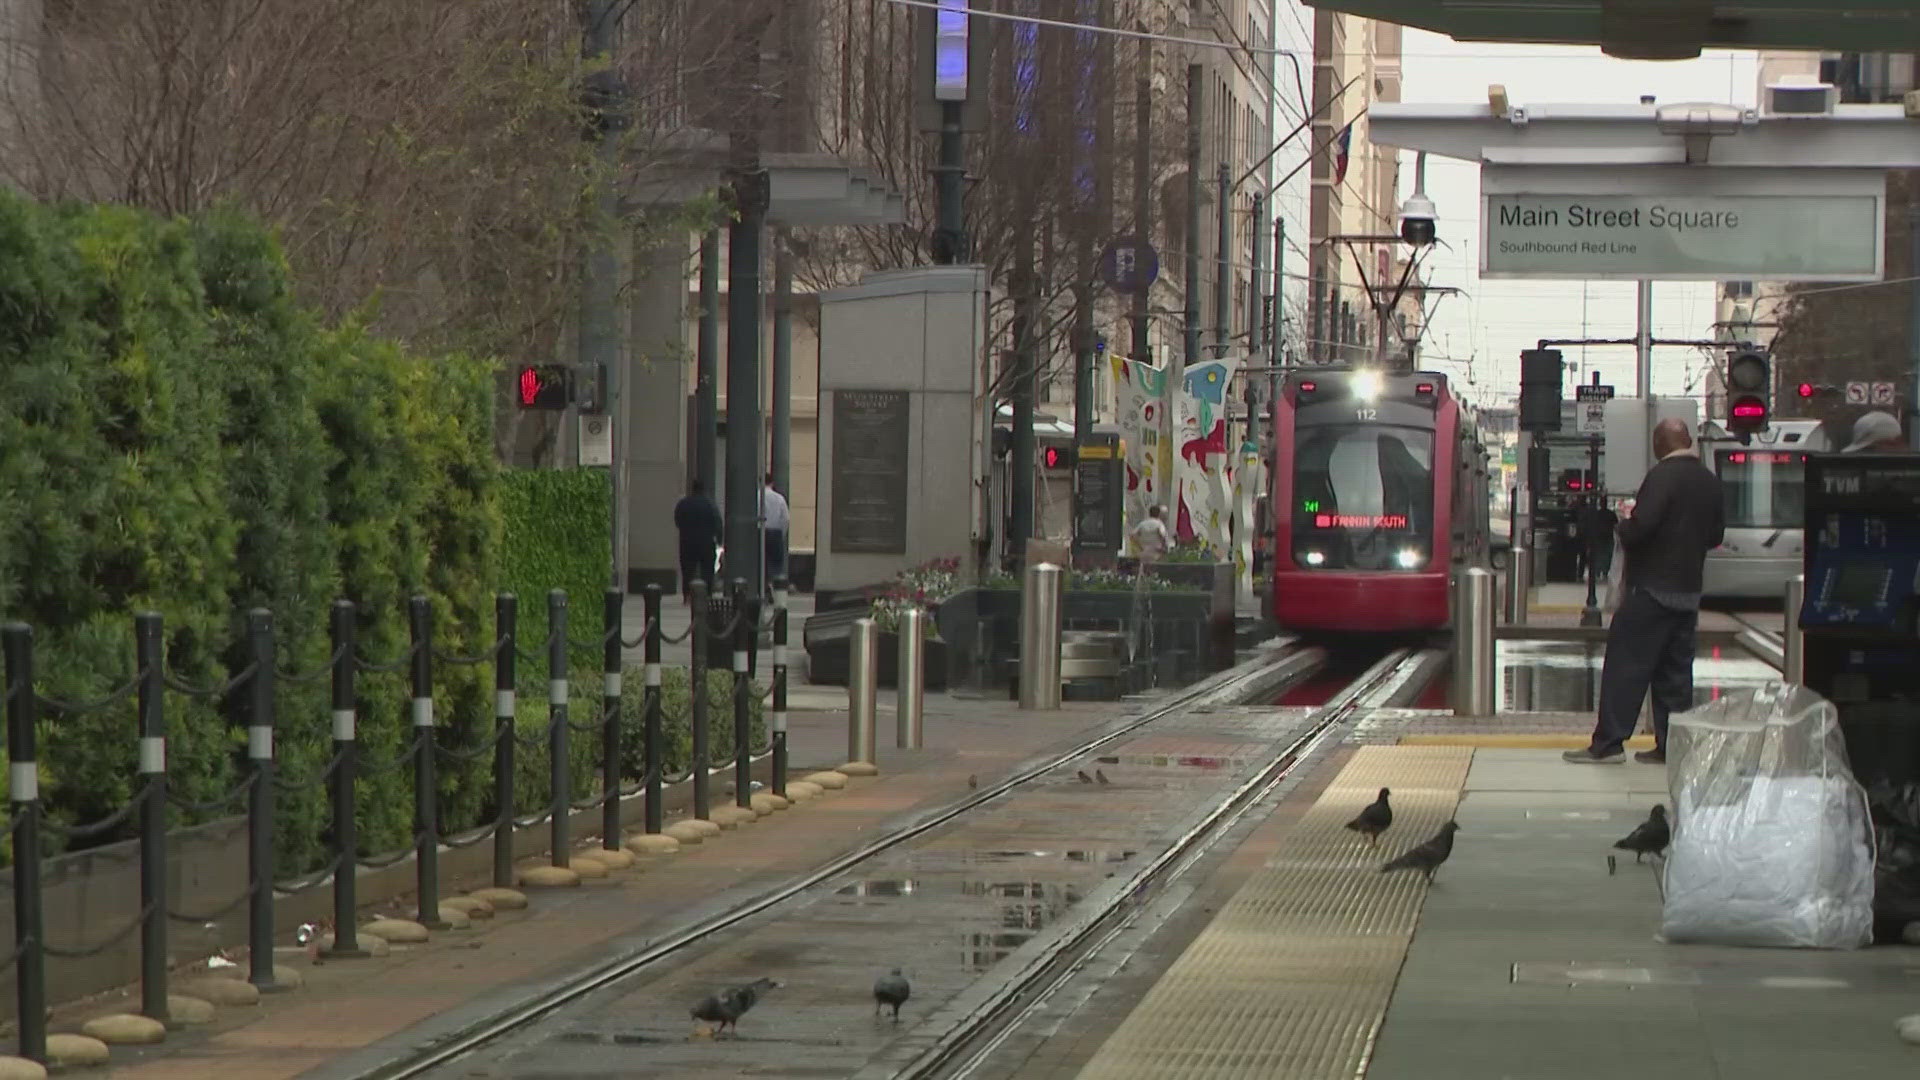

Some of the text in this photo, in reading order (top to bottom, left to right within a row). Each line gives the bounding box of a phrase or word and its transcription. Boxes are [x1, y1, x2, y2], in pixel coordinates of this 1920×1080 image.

[1500, 204, 1739, 233] Main Street Square
[1500, 240, 1637, 254] Southbound Red Line
[1356, 409, 1377, 420] 112
[1824, 476, 1860, 493] TVM
[1332, 516, 1406, 528] FANNIN SOUTH
